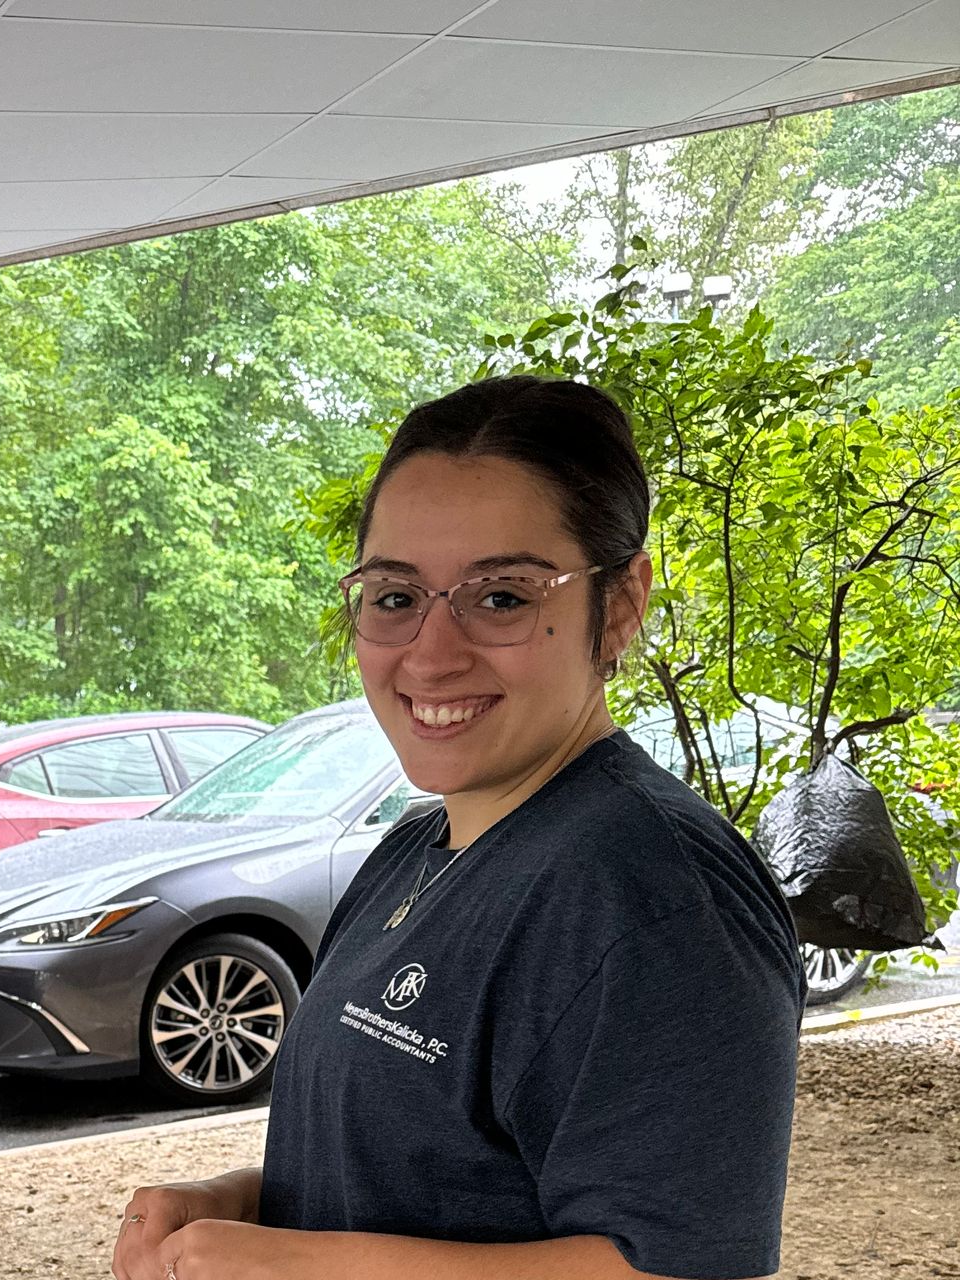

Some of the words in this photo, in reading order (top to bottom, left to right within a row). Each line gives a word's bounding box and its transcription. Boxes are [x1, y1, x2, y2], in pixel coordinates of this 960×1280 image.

[340, 1015, 362, 1029] CERTIFIED
[361, 1025, 382, 1039] PUBLIC
[382, 1034, 436, 1064] ACCOUNTANTS
